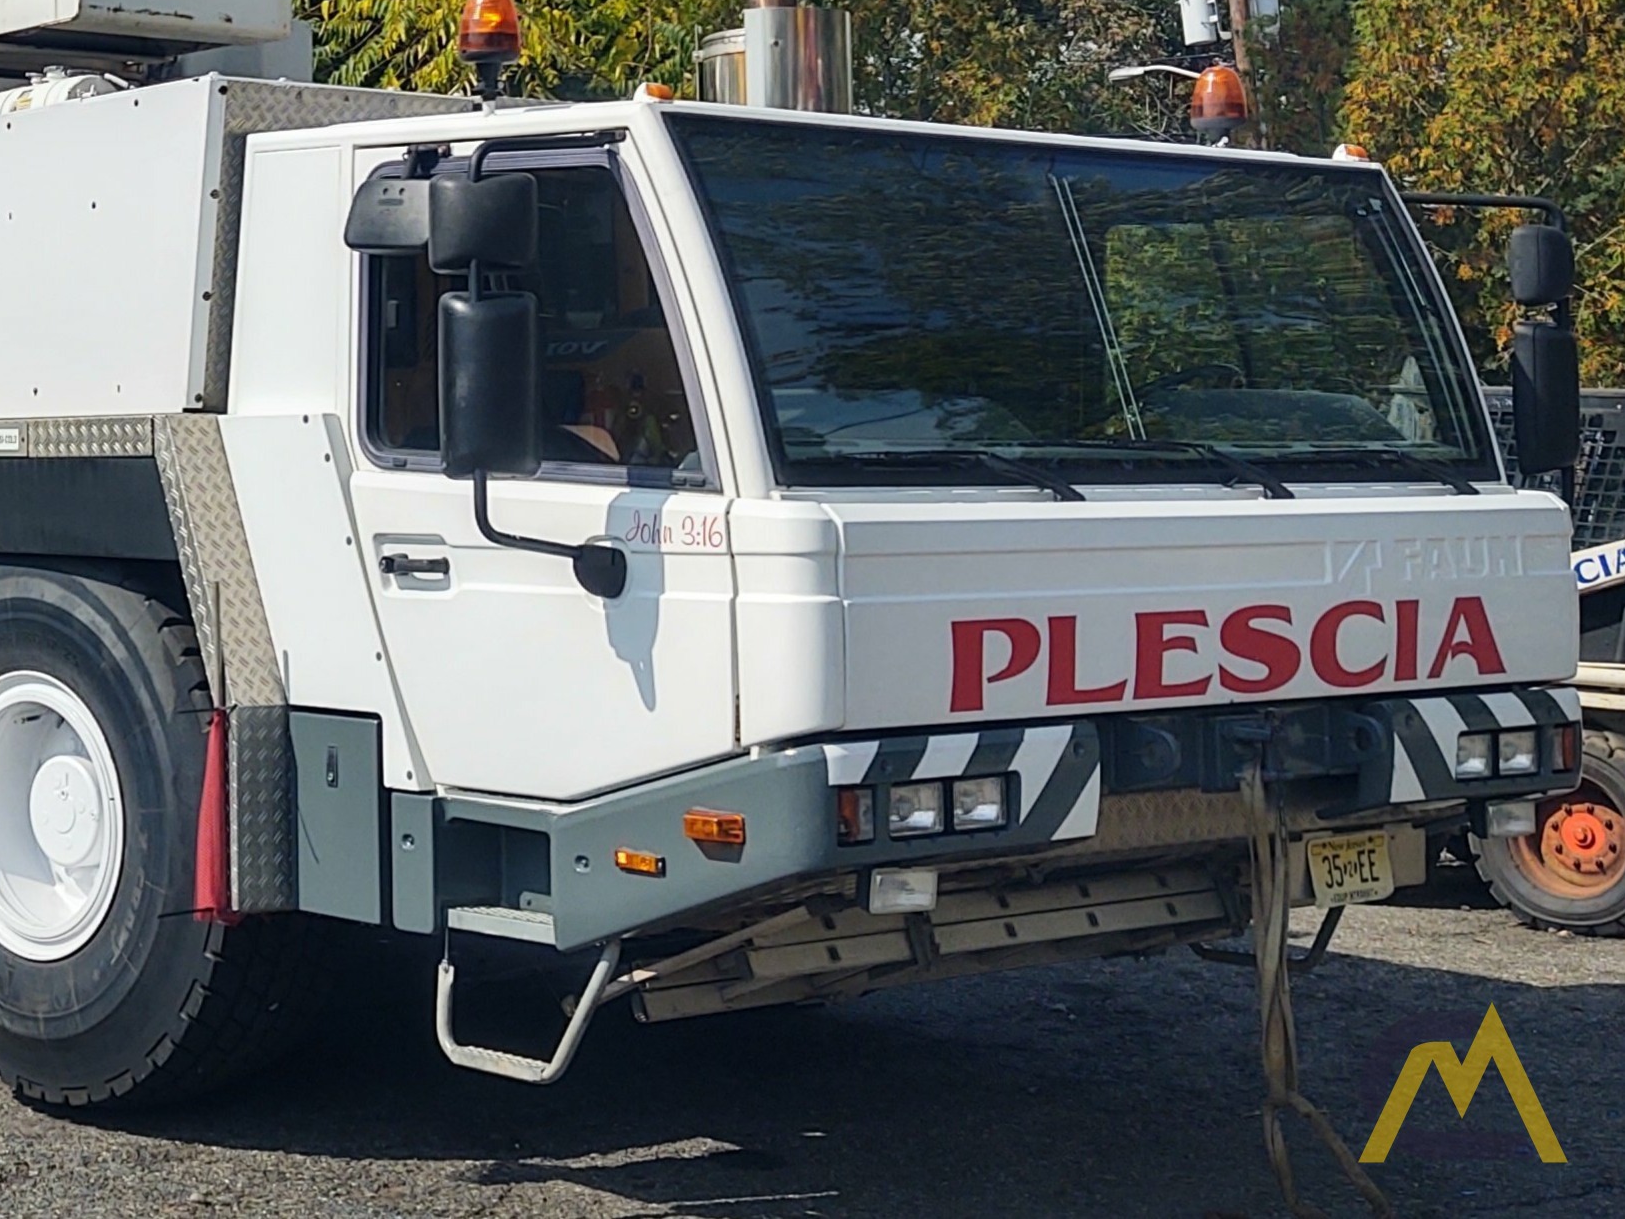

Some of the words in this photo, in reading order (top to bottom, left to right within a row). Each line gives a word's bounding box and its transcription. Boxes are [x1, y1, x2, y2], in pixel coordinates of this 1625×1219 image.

[625, 510, 674, 545] John
[681, 516, 723, 548] 3:16
[1396, 535, 1524, 582] FAUN
[949, 596, 1507, 713] PLESCIA
